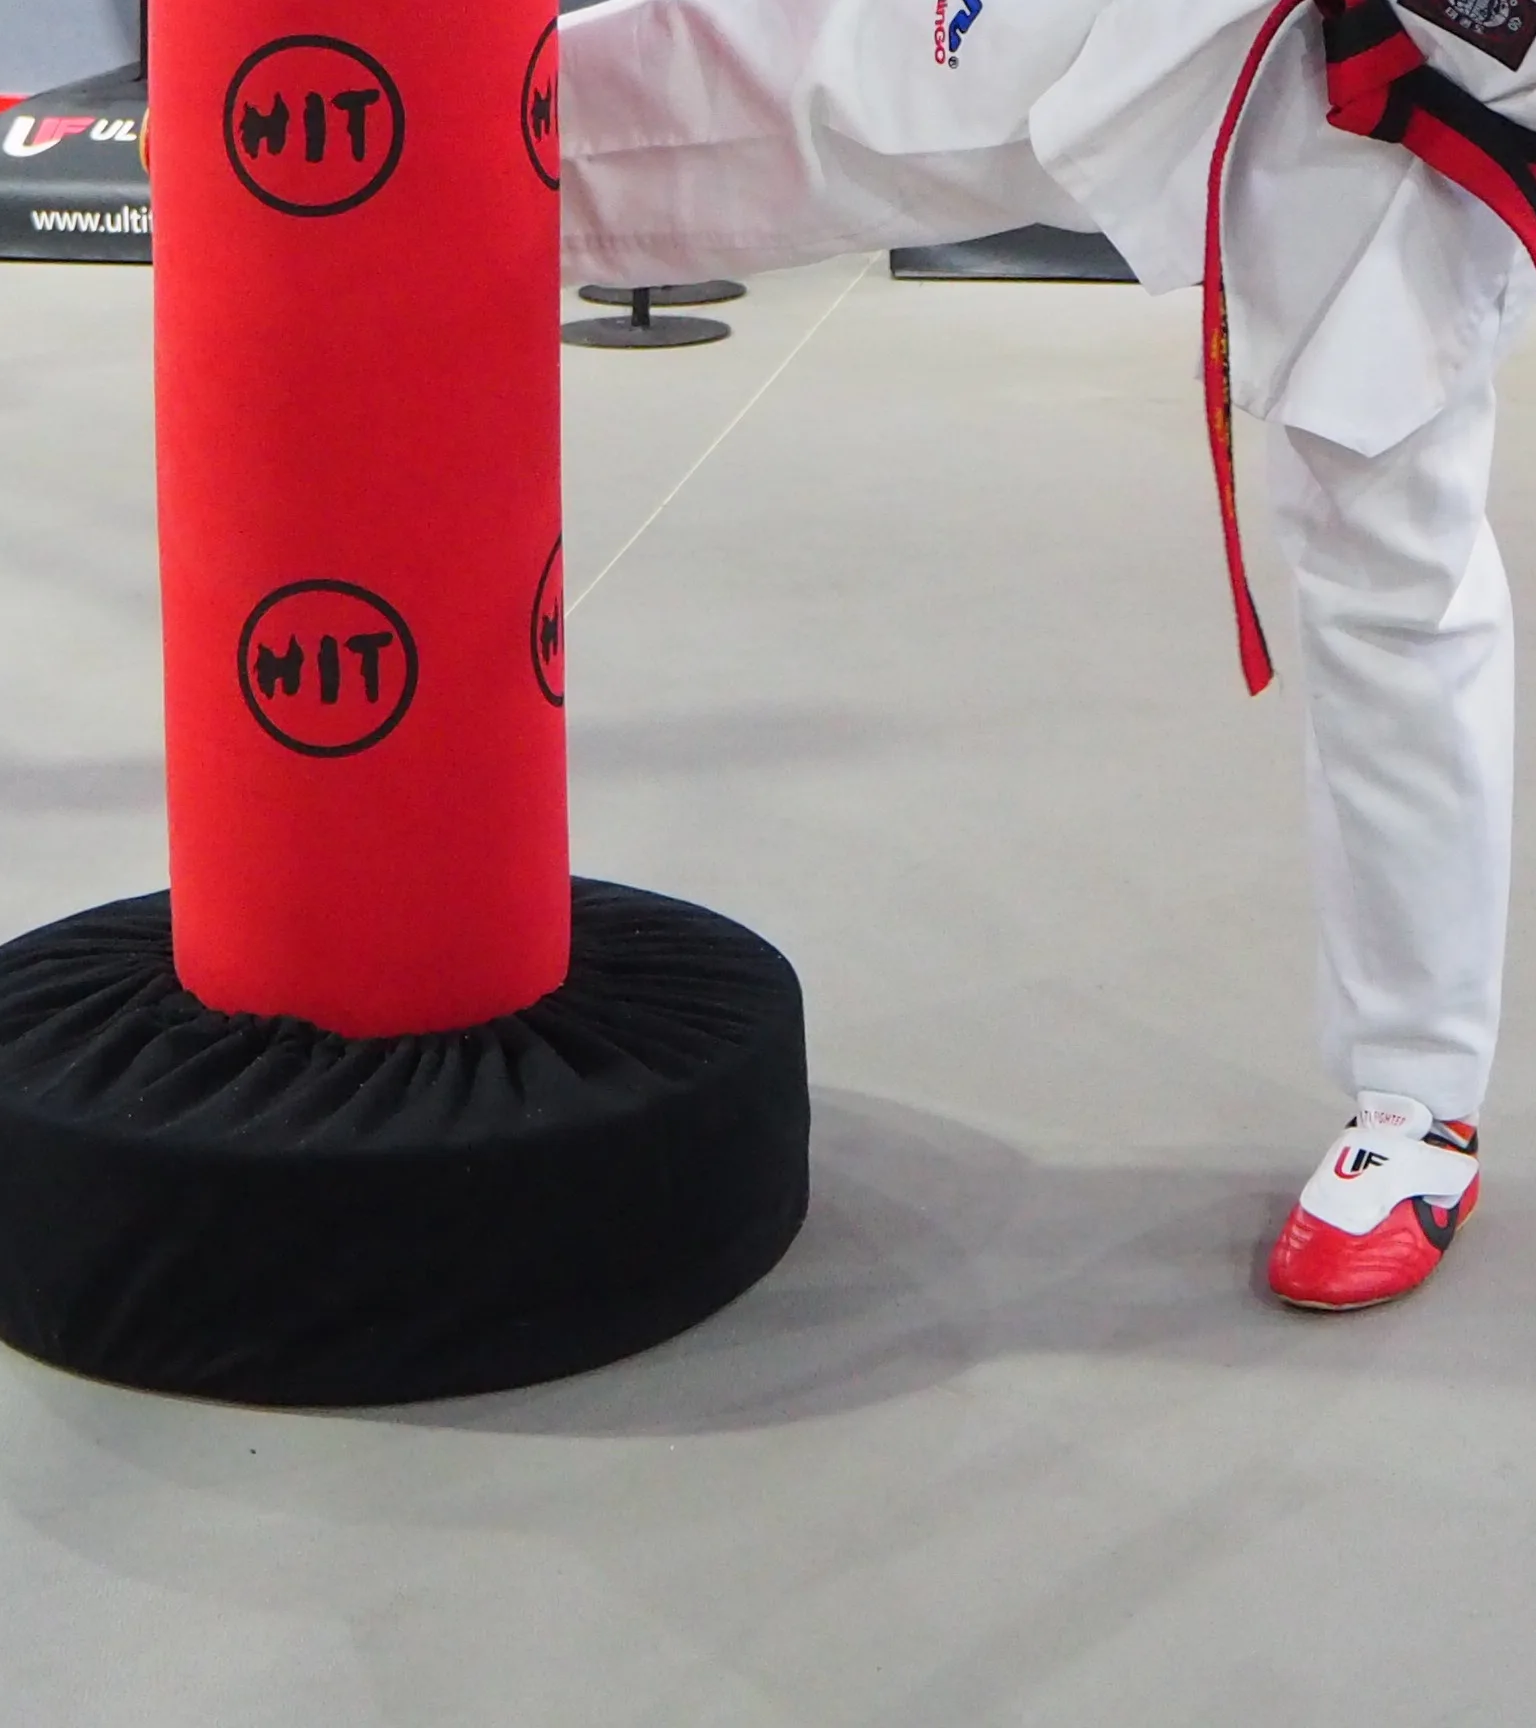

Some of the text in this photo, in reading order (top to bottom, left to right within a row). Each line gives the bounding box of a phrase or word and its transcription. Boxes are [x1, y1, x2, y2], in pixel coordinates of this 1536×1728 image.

[3, 116, 96, 157] UF
[240, 88, 381, 164] HIT
[254, 634, 394, 705] HIT
[1334, 1146, 1390, 1179] UF
